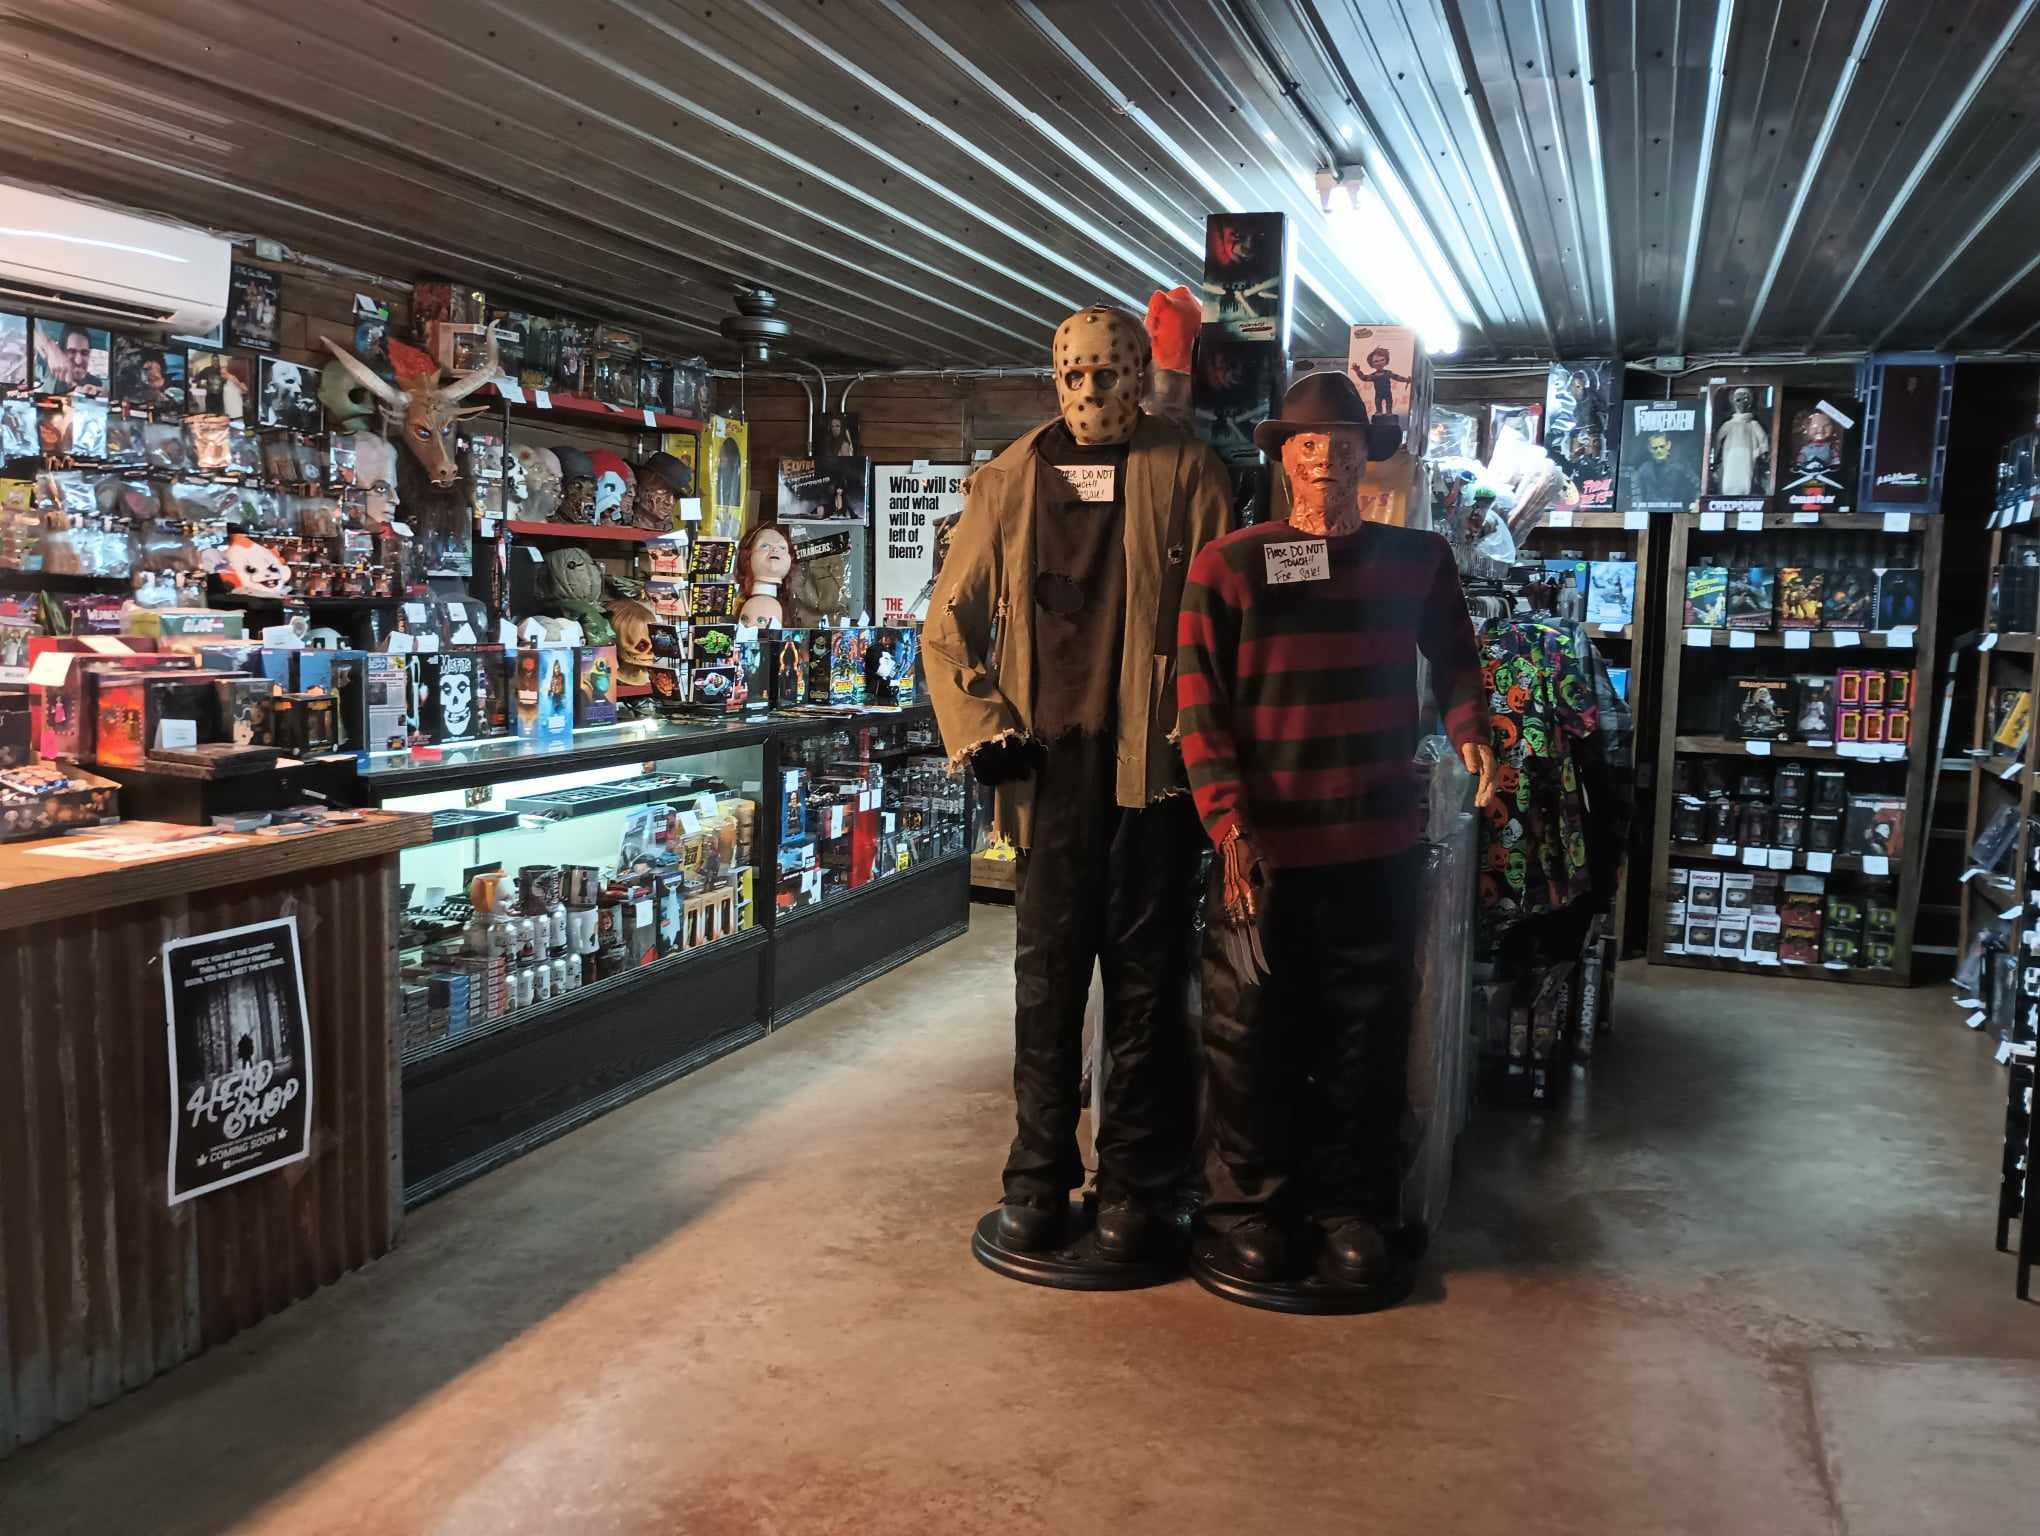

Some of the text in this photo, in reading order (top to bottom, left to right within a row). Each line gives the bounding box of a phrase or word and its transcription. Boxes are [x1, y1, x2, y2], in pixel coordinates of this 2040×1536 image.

[1082, 470, 1094, 480] DO
[1097, 469, 1113, 480] NOT
[889, 476, 919, 494] Who
[922, 475, 946, 494] will
[889, 496, 940, 510] and what
[889, 512, 926, 527] will be
[888, 528, 919, 543] left of
[888, 544, 924, 559] them?
[1290, 545, 1304, 558] DO
[1306, 543, 1325, 555] NOT
[885, 598, 904, 612] THE
[1580, 984, 1596, 1034] CHUCKY
[187, 1059, 273, 1128] HEAD
[209, 1142, 249, 1163] COMING
[249, 1132, 276, 1150] SOON
